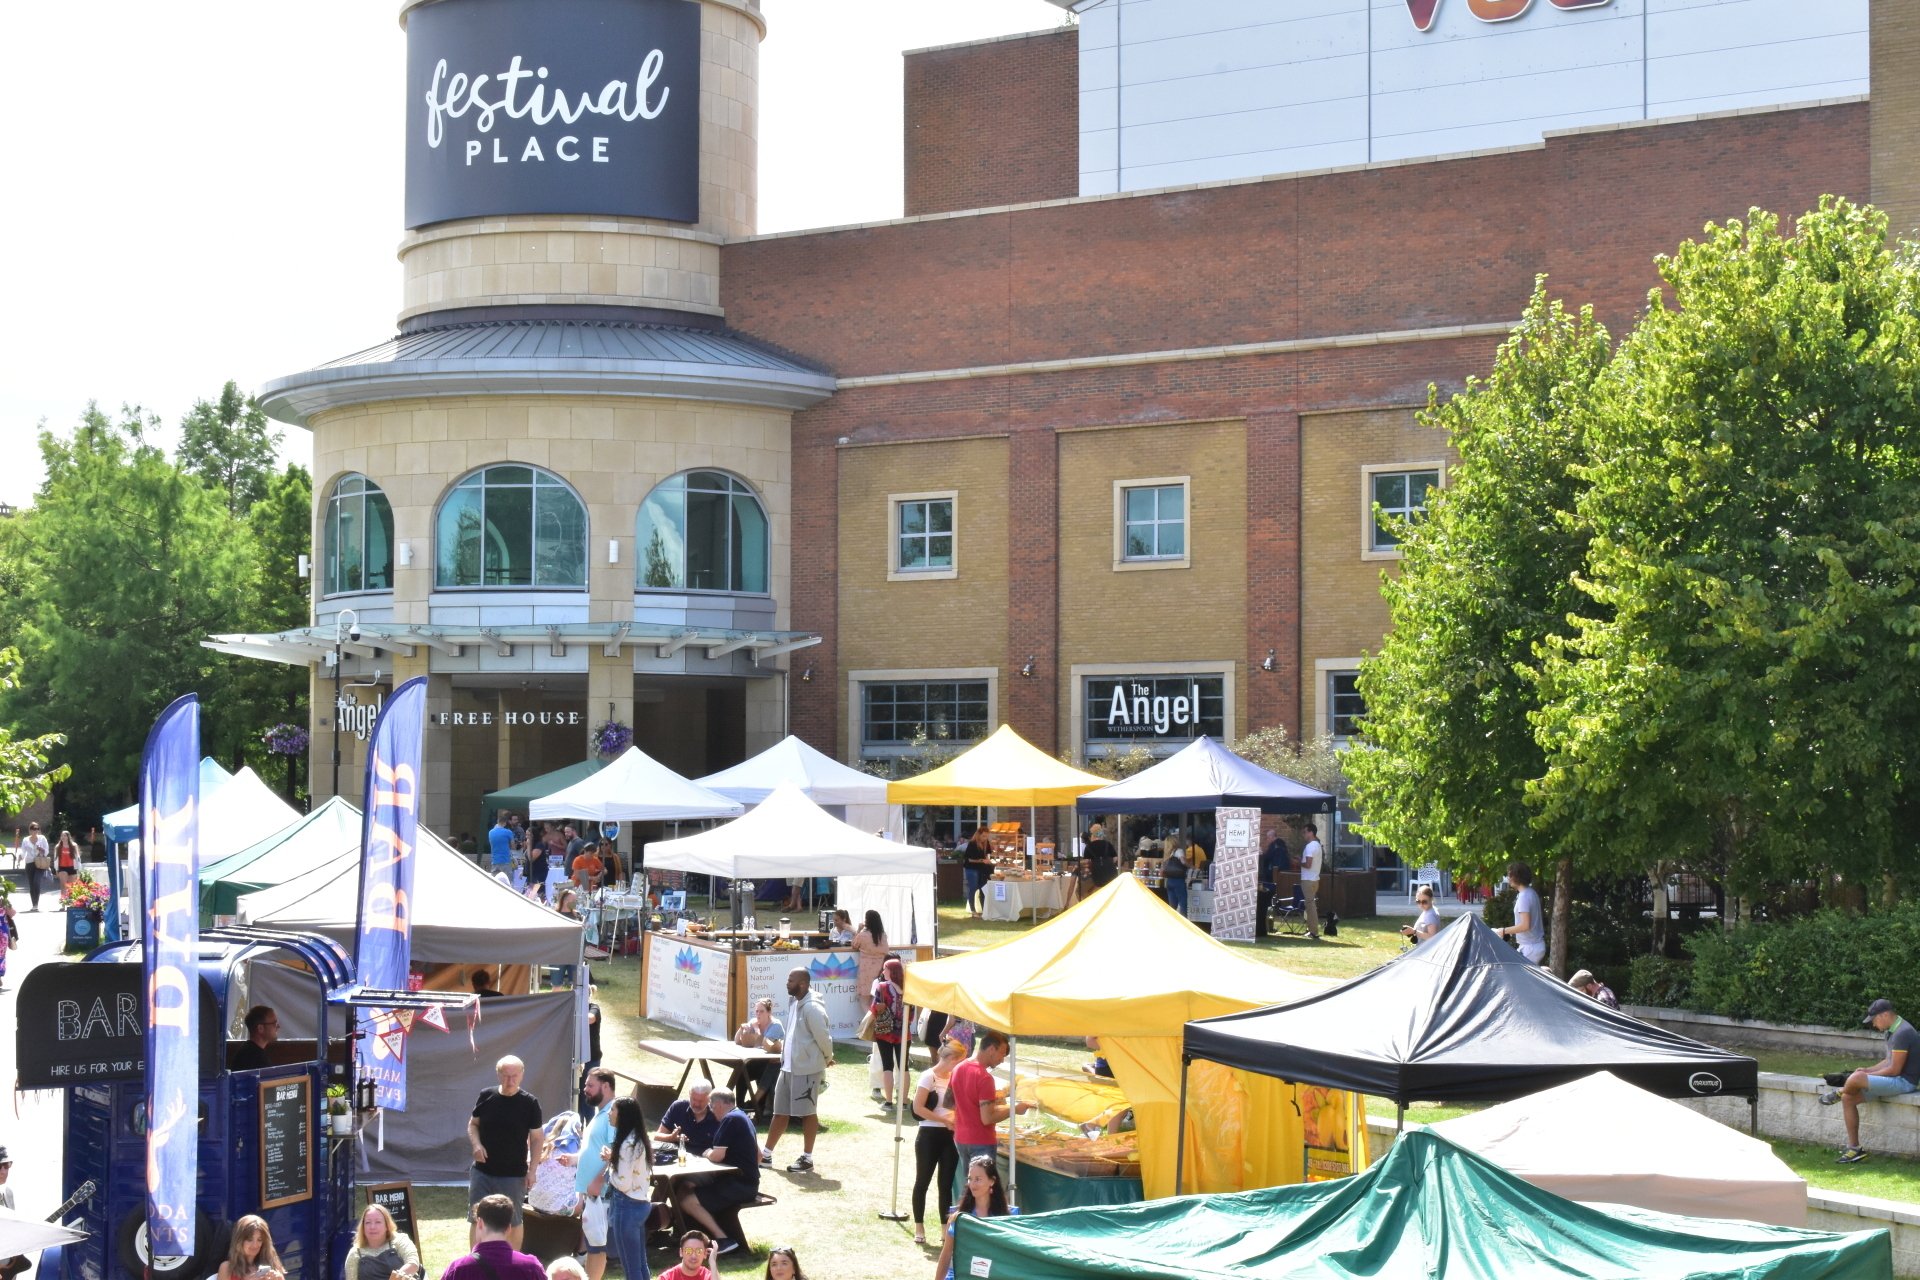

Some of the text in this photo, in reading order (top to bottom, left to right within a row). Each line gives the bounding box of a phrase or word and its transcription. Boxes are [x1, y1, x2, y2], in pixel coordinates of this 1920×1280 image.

[425, 49, 669, 148] festival
[466, 136, 609, 166] PLACE
[1131, 684, 1149, 696] The
[346, 693, 357, 705] The
[1108, 684, 1200, 734] Angel
[440, 712, 579, 725] FREE HOUSE
[750, 955, 788, 963] Plant-Based
[58, 993, 142, 1041] BAR
[51, 1065, 70, 1076] HIRE
[74, 1065, 86, 1075] US
[90, 1063, 107, 1074] FOR
[111, 1061, 132, 1071] YOUR
[276, 1090, 298, 1101] BAR MENU
[375, 1192, 405, 1203] BAR MENU
